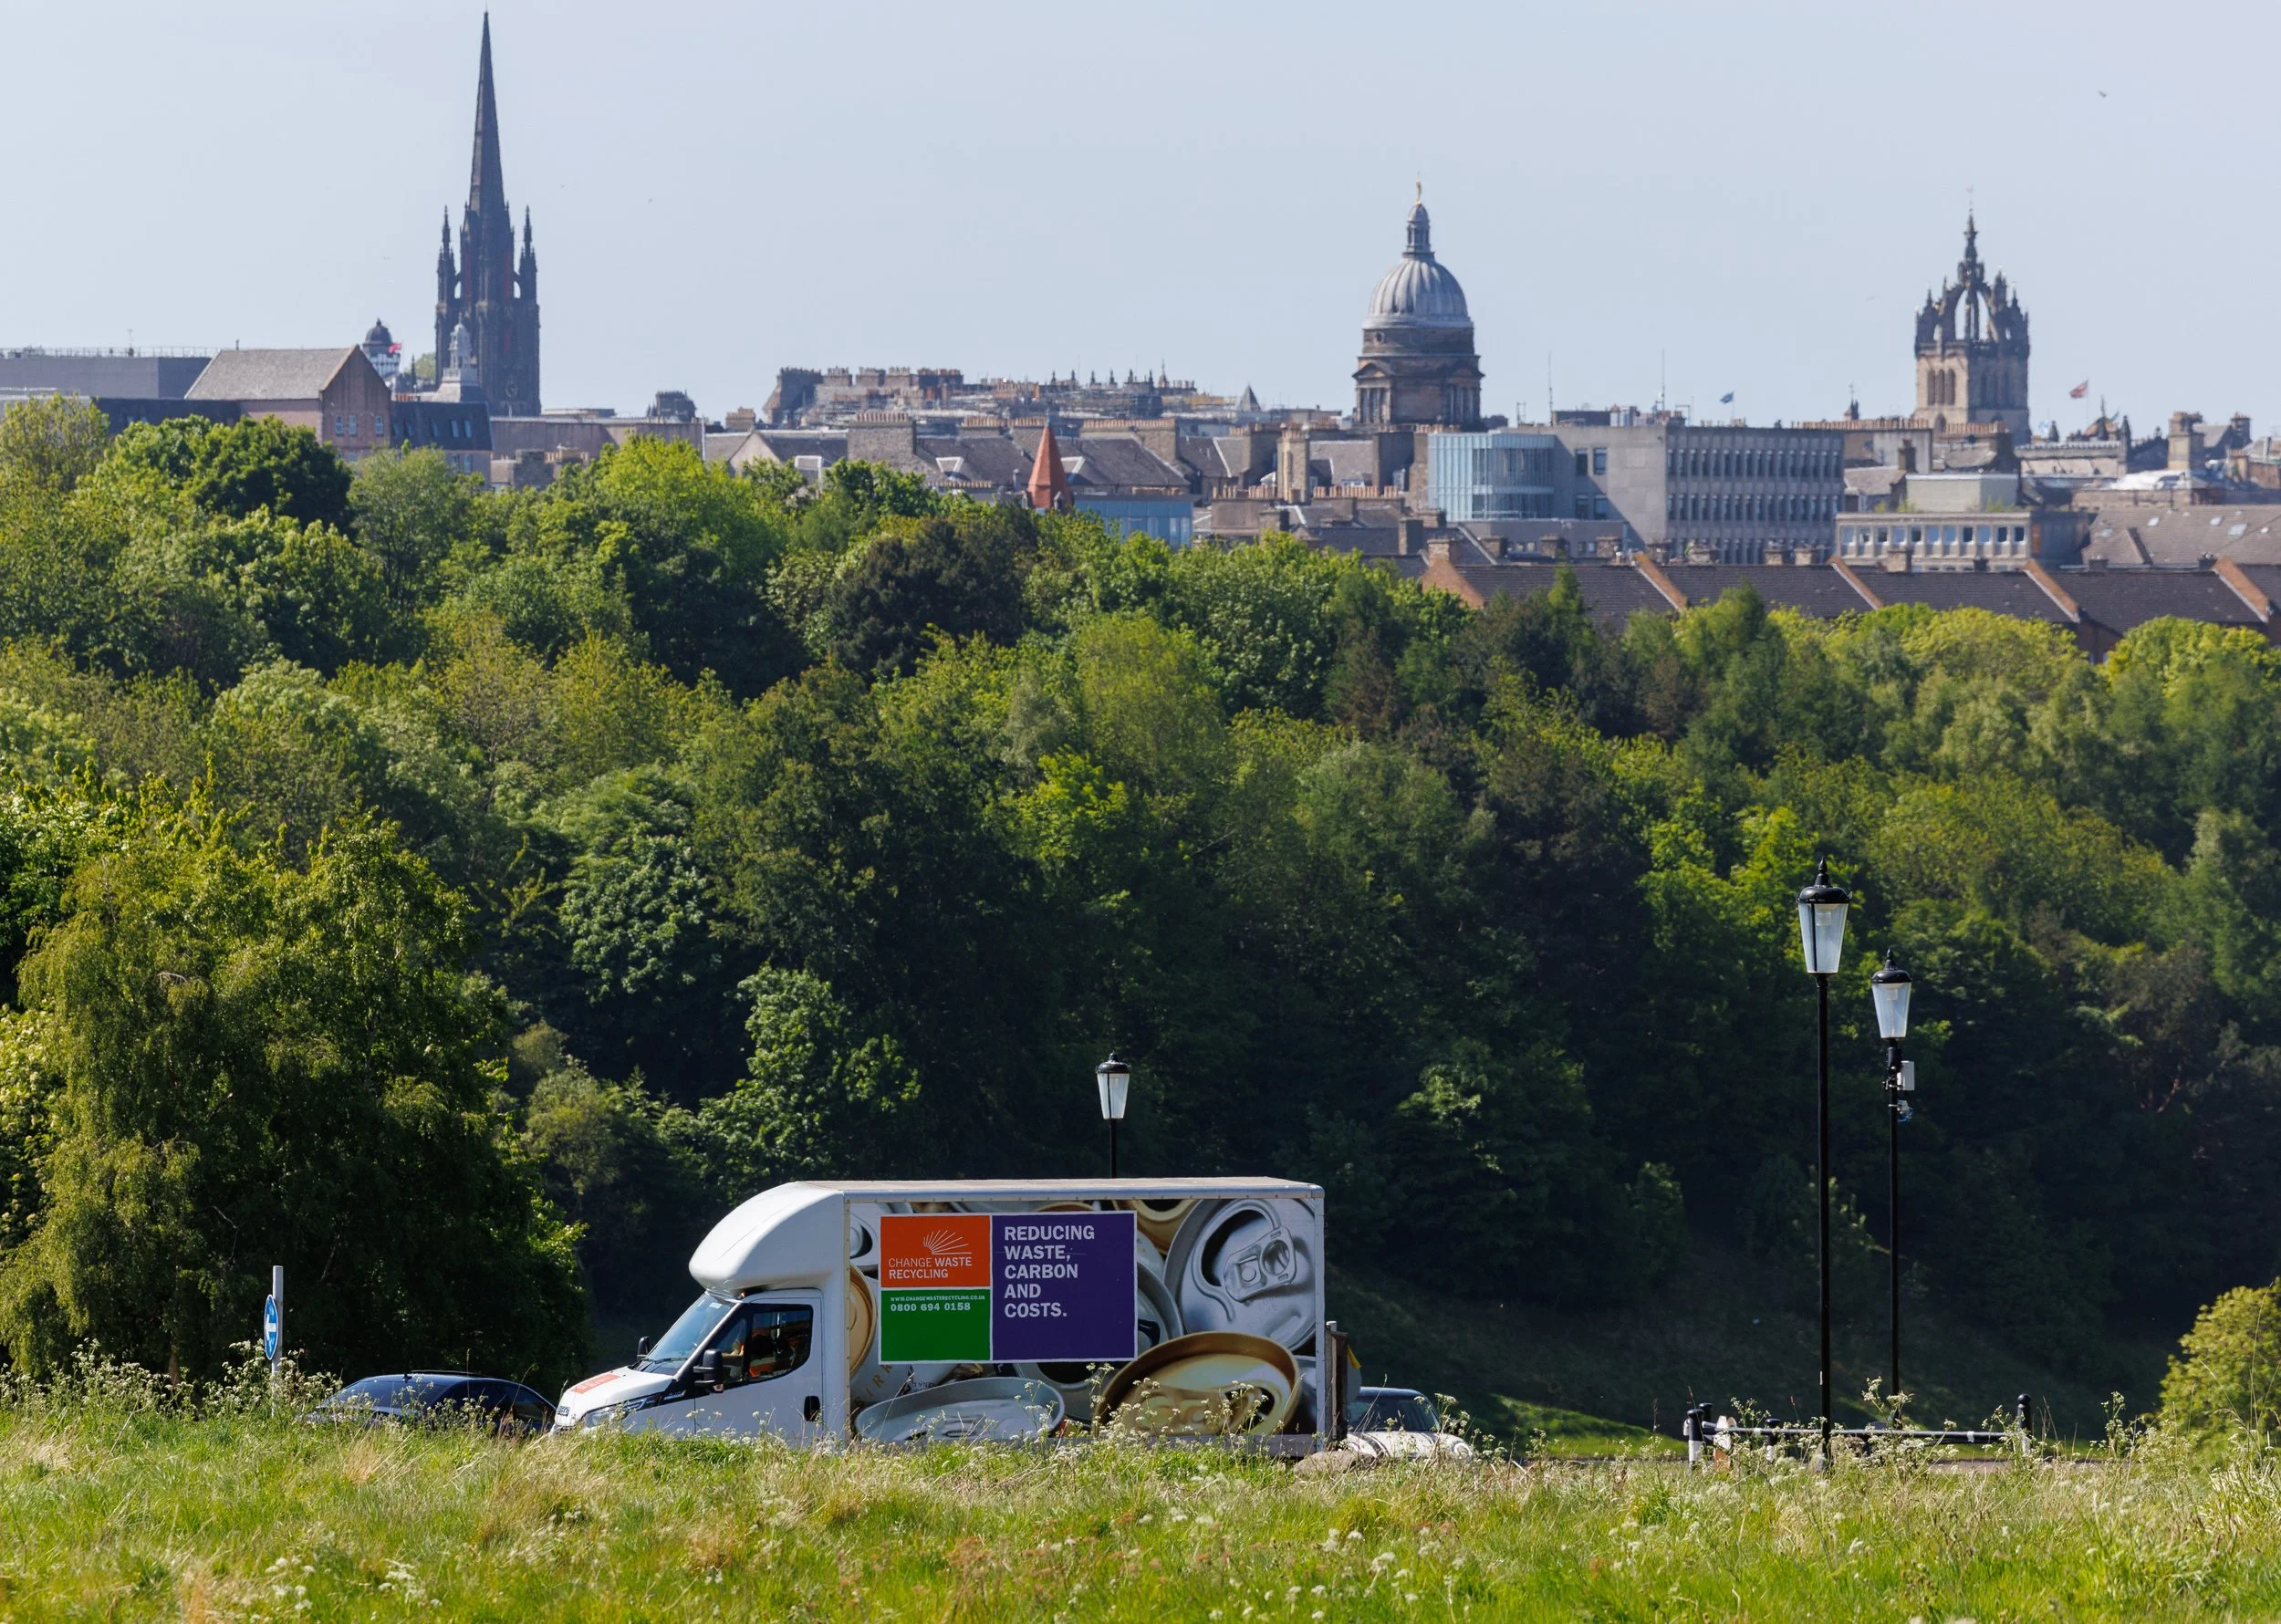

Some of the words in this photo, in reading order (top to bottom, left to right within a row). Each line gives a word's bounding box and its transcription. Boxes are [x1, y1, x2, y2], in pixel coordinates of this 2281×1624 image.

[1004, 1224, 1095, 1241] REDUCING
[1004, 1244, 1071, 1261] WASTE,
[888, 1257, 932, 1268] CHANGE
[934, 1256, 972, 1267] WASTE
[889, 1268, 949, 1279] RECYCLING
[1004, 1263, 1078, 1279] CARBON
[1004, 1283, 1041, 1299] AND
[891, 1303, 917, 1312] 0800
[920, 1302, 941, 1312] 694
[943, 1302, 971, 1311] 0158
[1004, 1302, 1068, 1318] COSTS.
